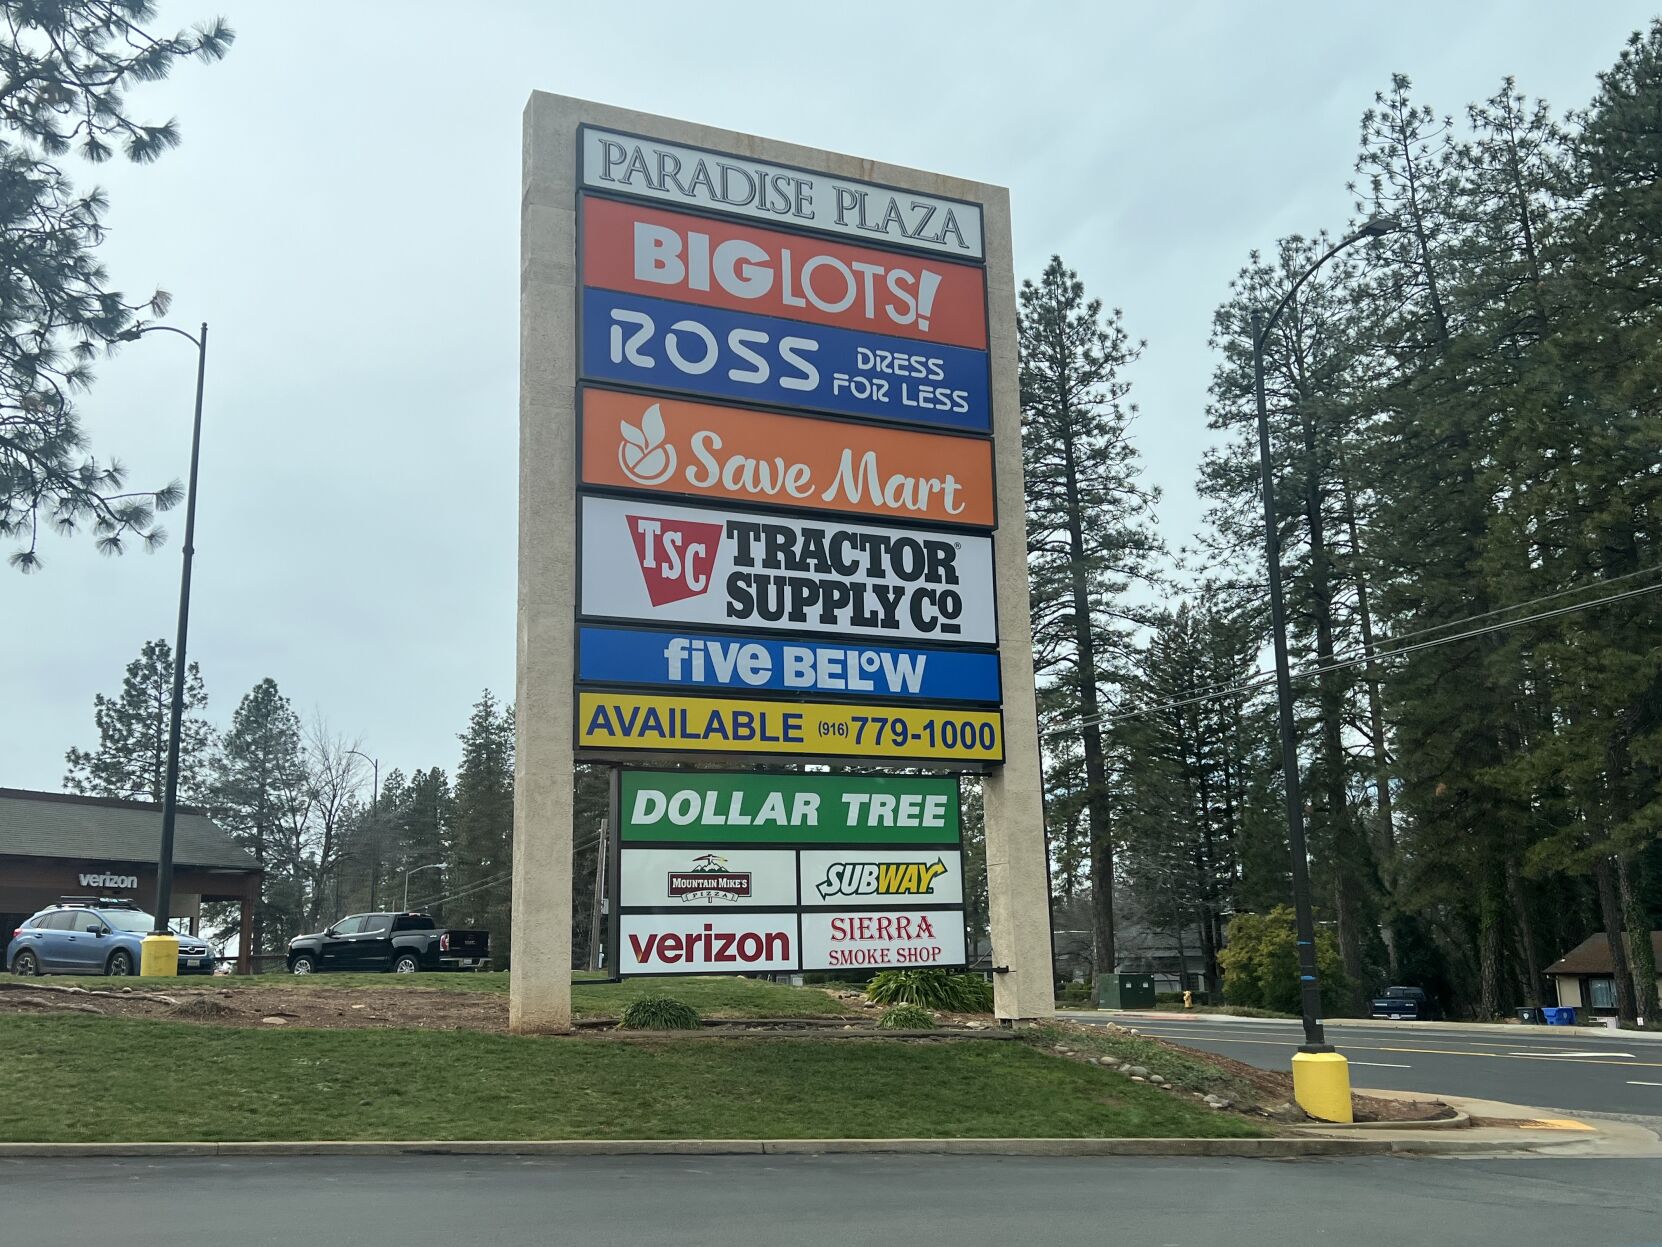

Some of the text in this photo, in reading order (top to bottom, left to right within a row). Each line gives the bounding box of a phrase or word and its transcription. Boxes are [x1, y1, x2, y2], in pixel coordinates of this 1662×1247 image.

[599, 138, 970, 249] PARADISE PLAZA
[610, 308, 820, 391] ROSS
[857, 346, 945, 381] DRESS
[833, 373, 969, 413] FOR LESS
[685, 430, 966, 515] Save Mart
[636, 519, 707, 592] TSC
[726, 571, 906, 630] SUPPLY
[663, 637, 927, 694] five BELOW
[586, 704, 804, 743] AVAILABLE
[630, 789, 949, 828] DOLLAR TREE
[79, 872, 138, 889] verizon
[692, 890, 729, 899] PIZZA
[815, 856, 949, 902] SUBWAY
[628, 923, 790, 964] verizon
[830, 915, 937, 942] SIERRA
[828, 946, 942, 966] SMOKE SHOP
